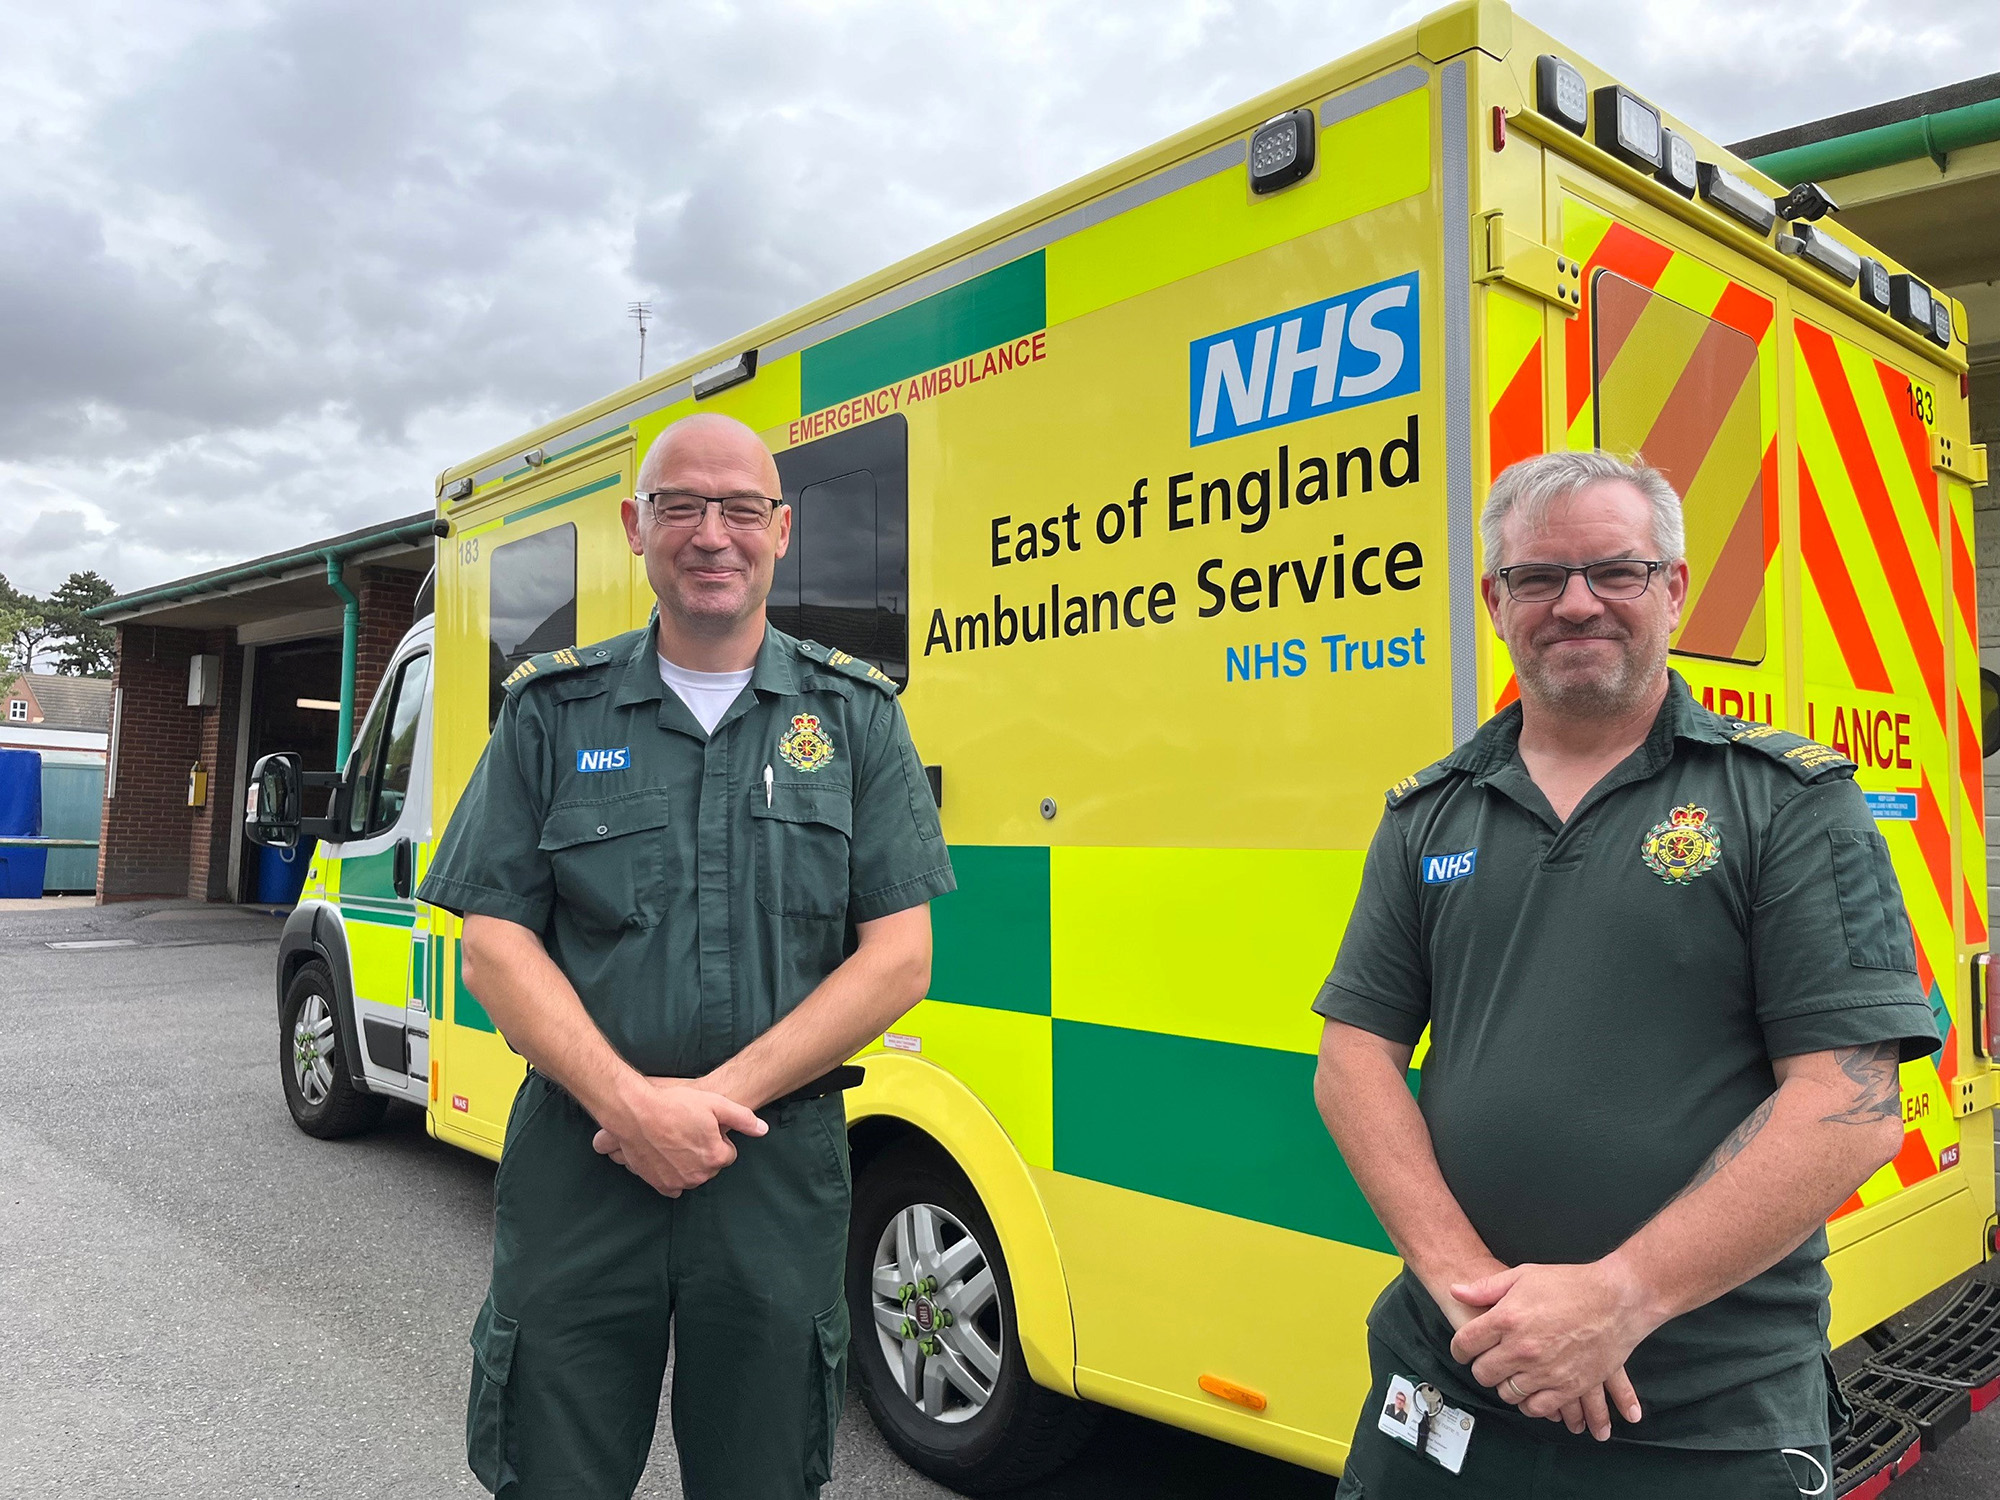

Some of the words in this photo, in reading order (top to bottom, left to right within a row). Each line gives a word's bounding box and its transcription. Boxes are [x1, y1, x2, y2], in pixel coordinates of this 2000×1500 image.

[1196, 284, 1413, 437] NHS
[788, 382, 902, 446] EMERGENCY
[906, 332, 1048, 405] AMBULANCE
[1907, 382, 1934, 426] 183
[990, 502, 1081, 567] East
[1096, 477, 1149, 545] of
[1168, 414, 1420, 533] England
[459, 537, 480, 567] 183
[923, 580, 1176, 656] Ambulance
[1197, 534, 1424, 618] Service
[1225, 638, 1307, 683] NHS
[1321, 627, 1426, 672] Trust
[580, 748, 625, 770] NHS
[1428, 850, 1473, 881] NHS
[1901, 1093, 1930, 1124] LEAR
[1941, 1148, 1957, 1166] WAS
